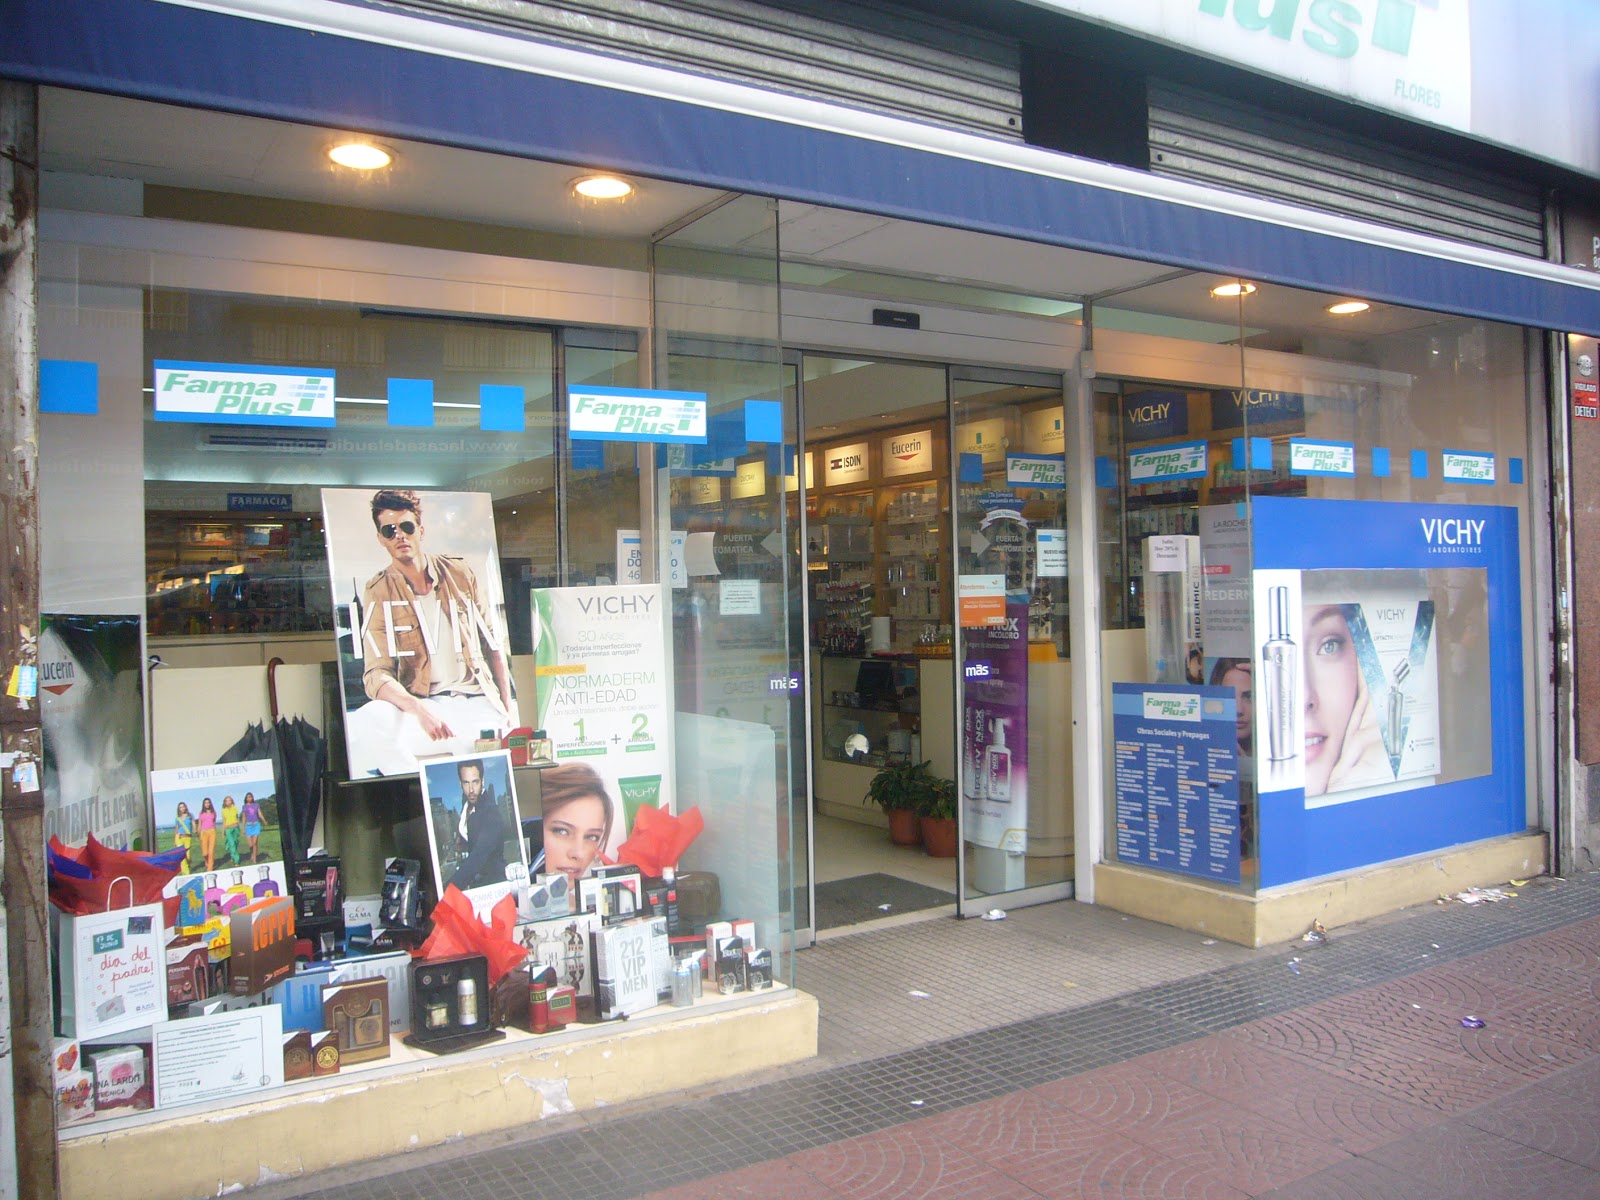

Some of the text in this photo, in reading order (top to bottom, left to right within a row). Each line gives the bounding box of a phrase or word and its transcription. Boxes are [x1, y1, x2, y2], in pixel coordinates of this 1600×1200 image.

[1199, 0, 1363, 59] us
[1394, 78, 1441, 109] FLORES
[162, 372, 277, 397] Farma
[214, 394, 293, 417] Plus
[575, 396, 662, 418] Farma
[1128, 402, 1170, 424] VICHY
[1575, 406, 1597, 418] DETECT
[615, 416, 675, 435] Plus
[891, 438, 921, 455] Eucerin
[1293, 445, 1334, 460] Farma
[843, 454, 861, 469] ISDIN
[1010, 459, 1056, 472] Farma
[1133, 452, 1181, 467] Farma
[1312, 458, 1341, 472] Plus
[1446, 455, 1479, 468] Farma
[1154, 462, 1188, 475] Plus
[1461, 467, 1484, 479] Plus
[1031, 470, 1063, 483] Plus
[231, 495, 288, 507] FARMACIA
[723, 534, 753, 542] PUERTA
[995, 535, 1019, 543] PUERTA
[1420, 518, 1485, 545] VICHY
[577, 594, 655, 615] VICHY
[1376, 608, 1406, 621] VICHY
[348, 599, 500, 660] KEVIN
[578, 630, 625, 642] 30 AÑOS
[988, 630, 1020, 640] INCOLORO
[41, 655, 75, 682] ucerin
[554, 671, 656, 690] NORMADERM
[555, 688, 636, 706] ANTI-EDAD
[1146, 697, 1181, 708] Farma
[1161, 706, 1187, 717] Plus
[573, 717, 585, 743] 1
[631, 713, 649, 740] 2
[1136, 727, 1154, 735] Obras
[1154, 728, 1177, 737] Sociales
[1182, 731, 1210, 740] Prepagas
[177, 766, 209, 781] RALPH
[211, 765, 248, 778] LAUREN
[624, 786, 657, 798] VICHY
[301, 879, 325, 887] TRIMMER
[99, 940, 119, 949] JUNIO
[619, 937, 645, 960] 212
[131, 945, 151, 961] del
[622, 955, 646, 979] VIP
[111, 961, 154, 993] padre!
[622, 973, 649, 996] MEN
